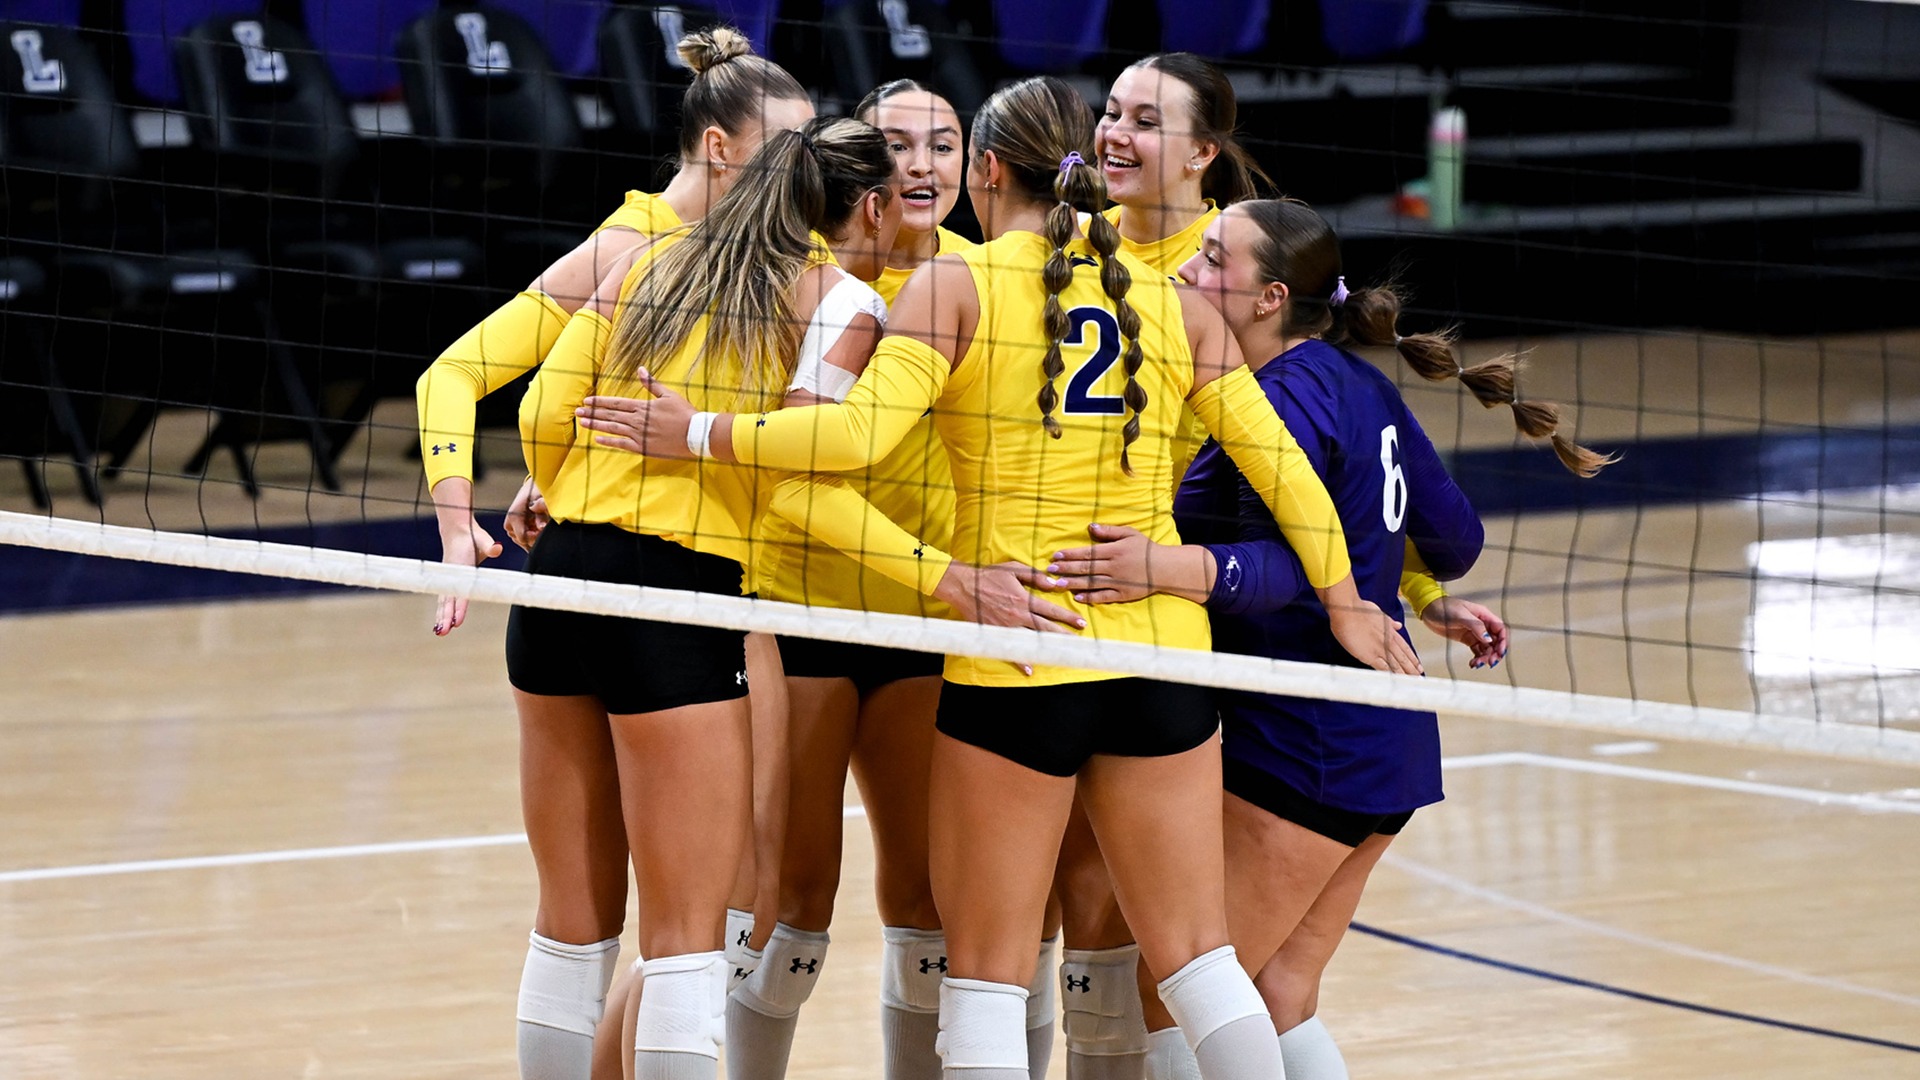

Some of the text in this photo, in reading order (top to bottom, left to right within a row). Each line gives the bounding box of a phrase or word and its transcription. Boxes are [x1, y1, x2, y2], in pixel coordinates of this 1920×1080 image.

[10, 29, 66, 92] L
[231, 20, 288, 82] L
[453, 12, 511, 75] L
[1061, 305, 1125, 415] 2
[1380, 424, 1407, 533] 6
